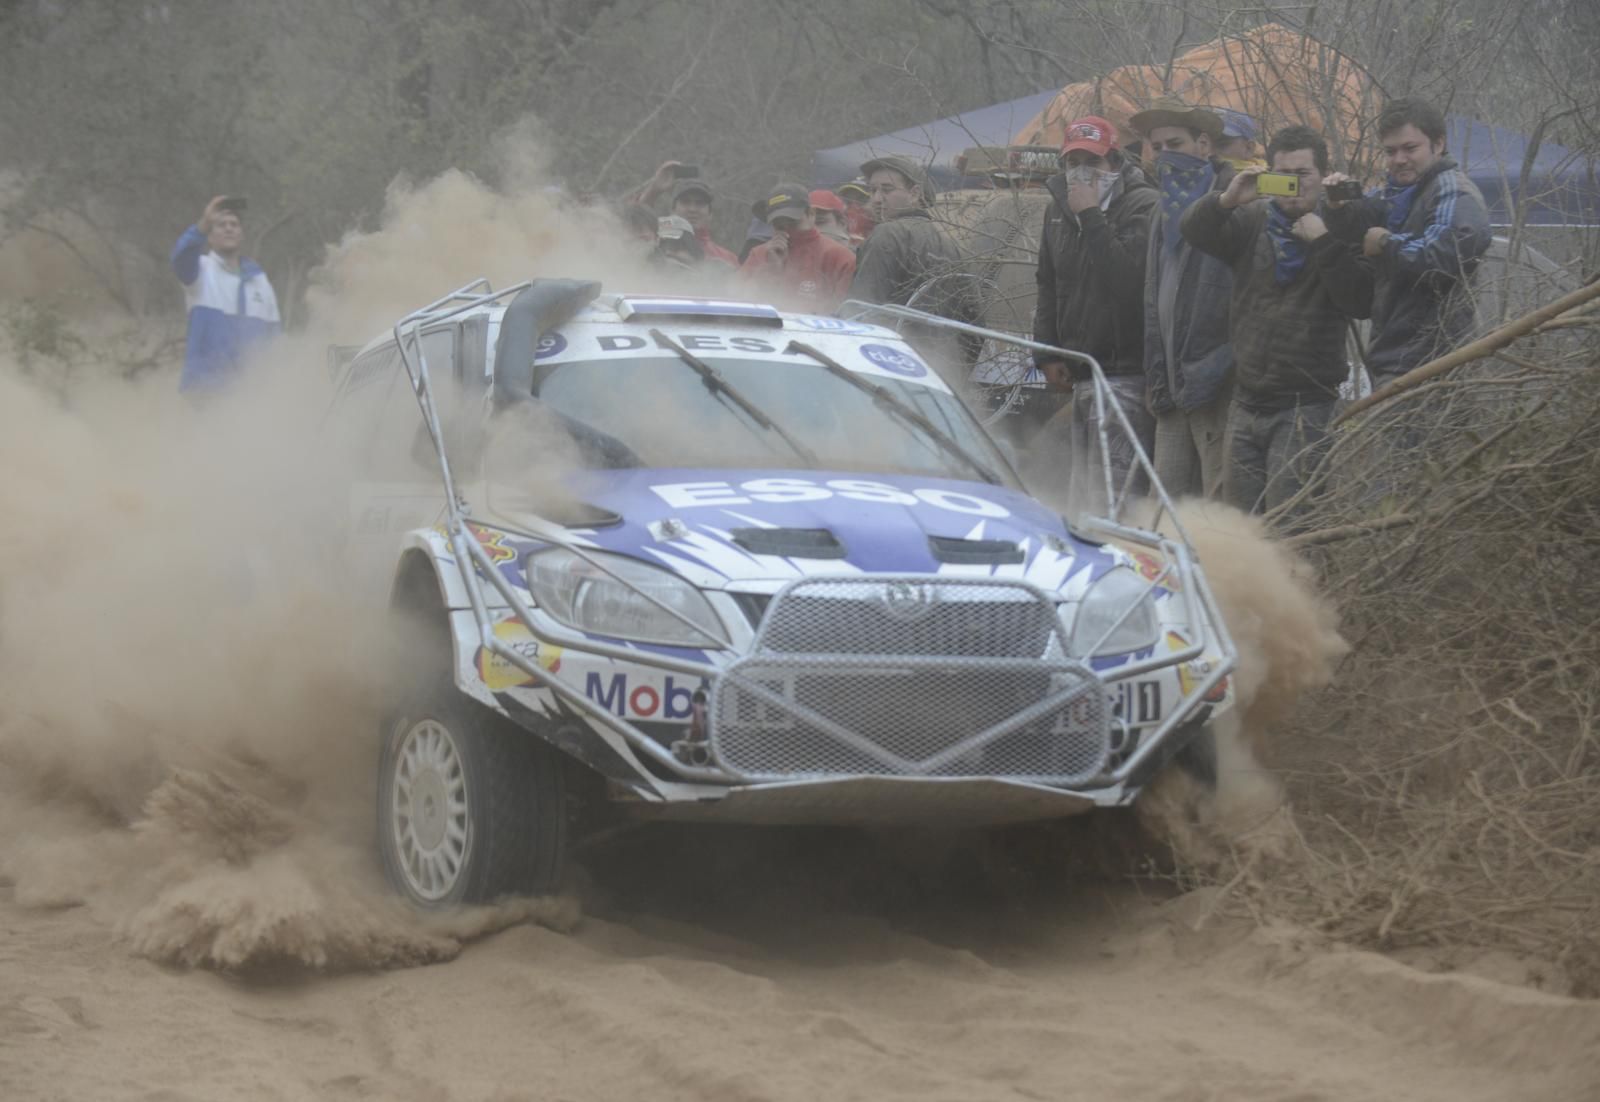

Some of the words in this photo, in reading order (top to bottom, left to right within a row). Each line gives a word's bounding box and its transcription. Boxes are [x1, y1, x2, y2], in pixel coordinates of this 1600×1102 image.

[595, 334, 800, 356] DES
[649, 478, 1011, 518] ESSO
[586, 672, 712, 719] Mob
